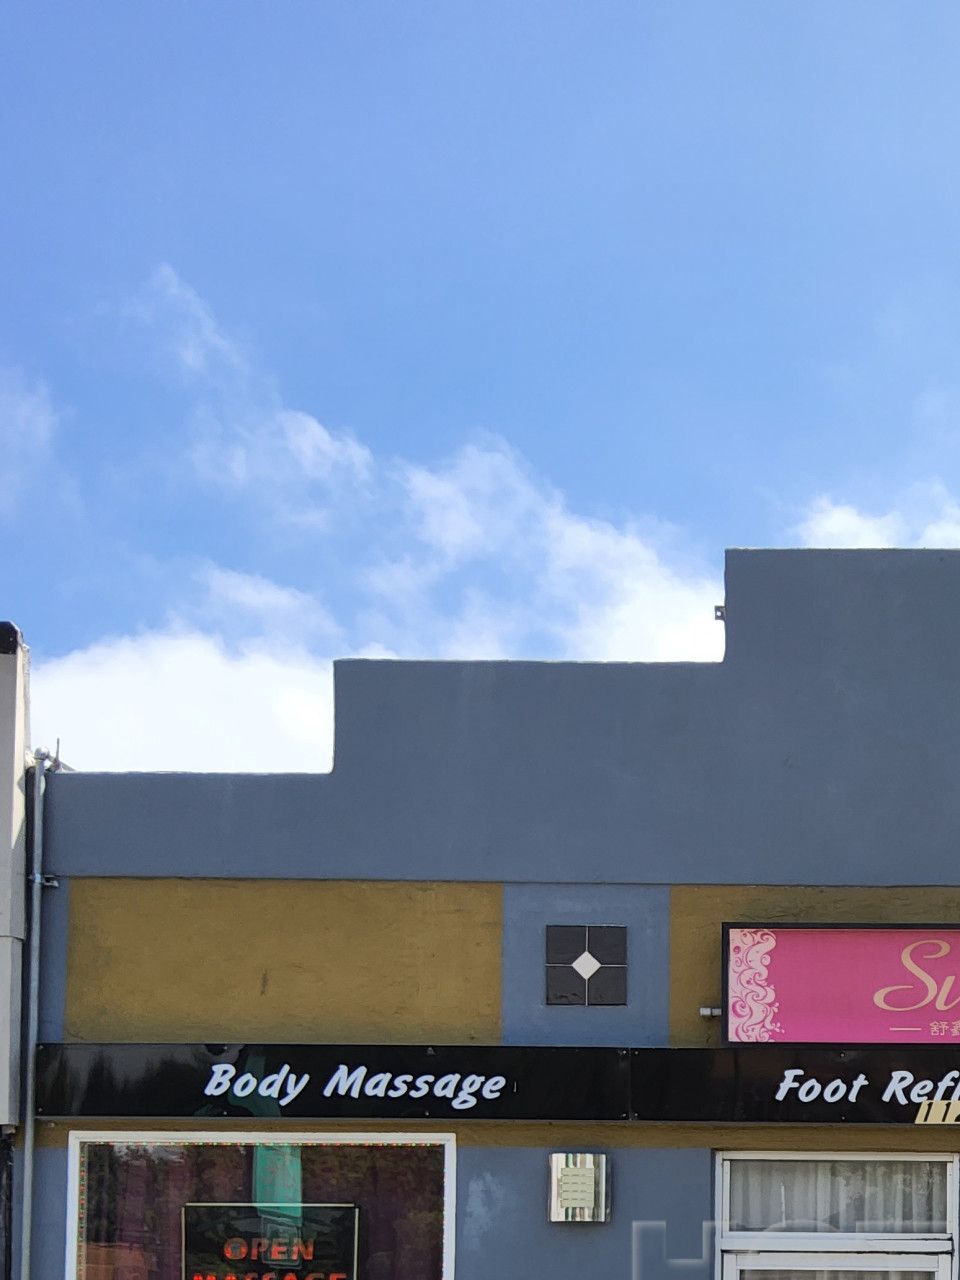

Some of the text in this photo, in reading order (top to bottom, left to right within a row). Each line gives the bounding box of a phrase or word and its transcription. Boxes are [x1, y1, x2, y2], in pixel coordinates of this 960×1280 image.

[204, 1064, 507, 1109] Body Massage
[775, 1069, 869, 1102] Foot
[223, 1237, 314, 1261] OPEN
